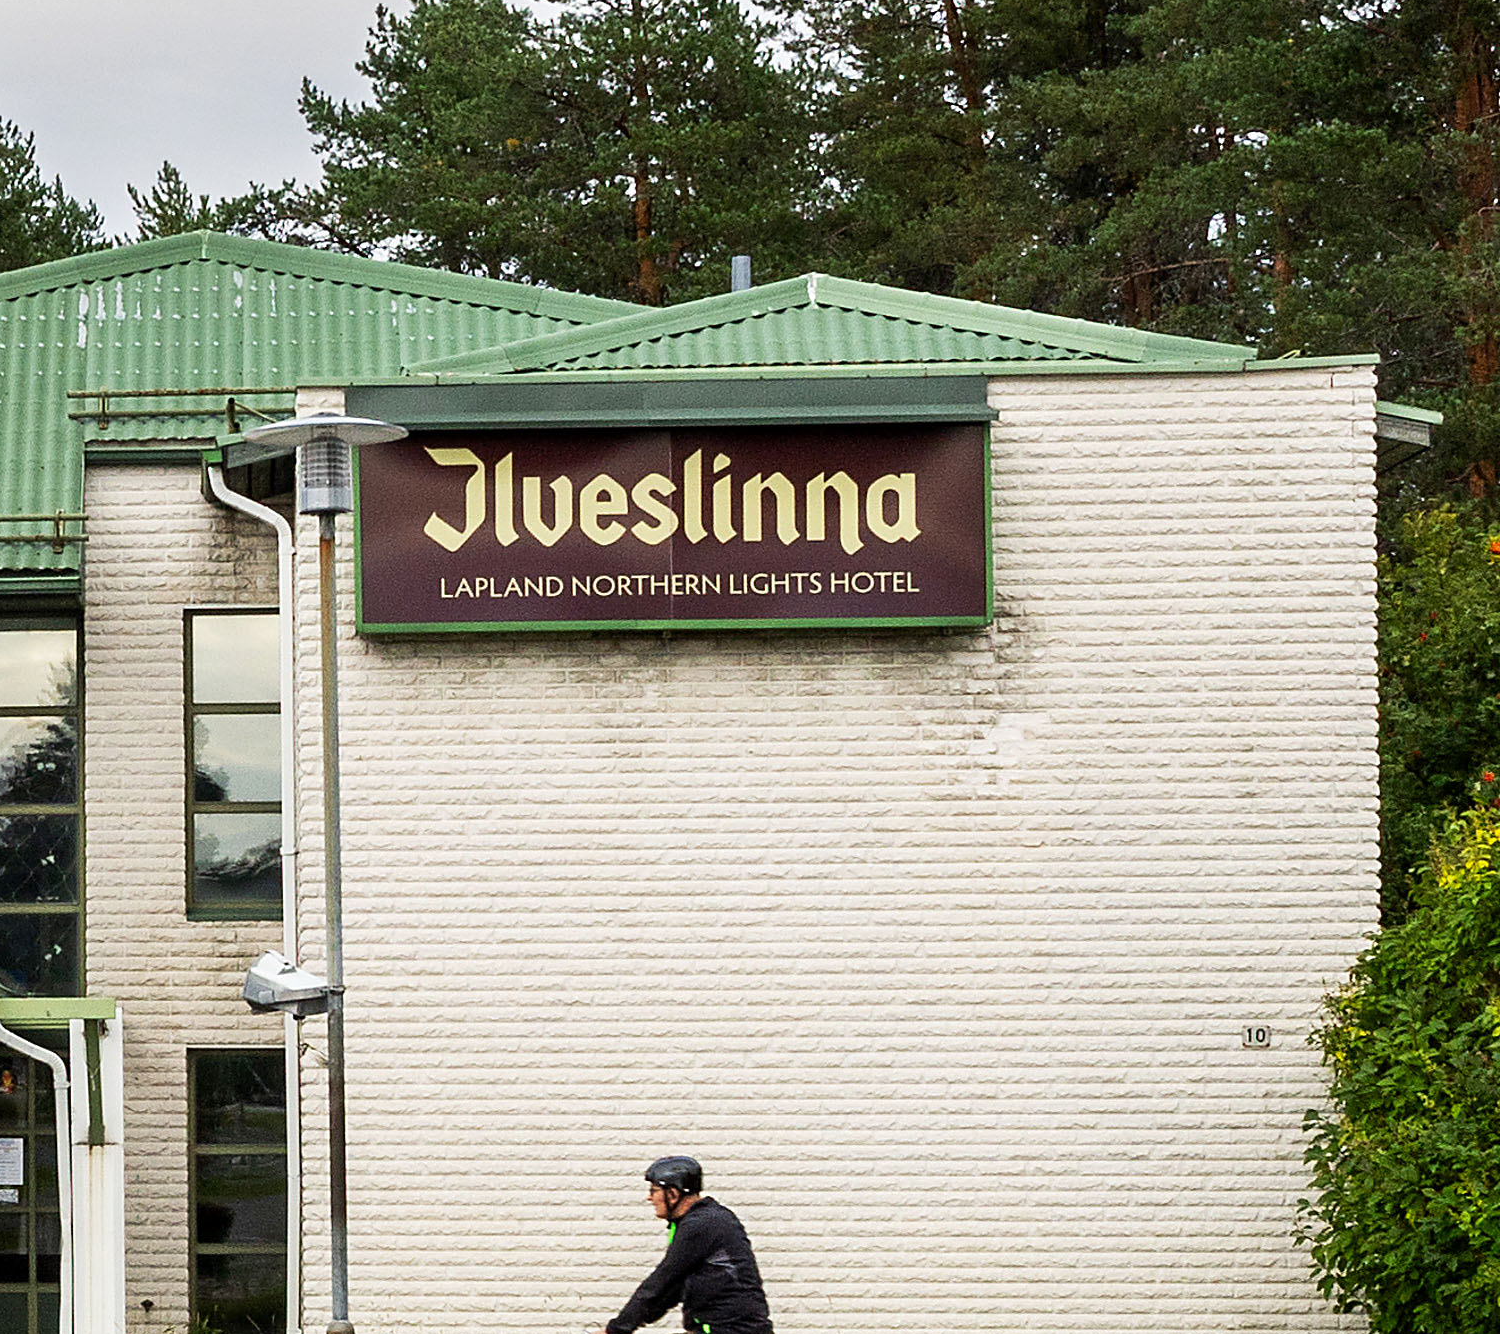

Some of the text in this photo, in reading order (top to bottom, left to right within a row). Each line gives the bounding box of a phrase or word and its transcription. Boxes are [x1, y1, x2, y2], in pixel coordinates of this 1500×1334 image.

[440, 569, 920, 599] LAPLAND NORTHERN LIGHTS HOTEL
[1246, 1028, 1266, 1043] 10
